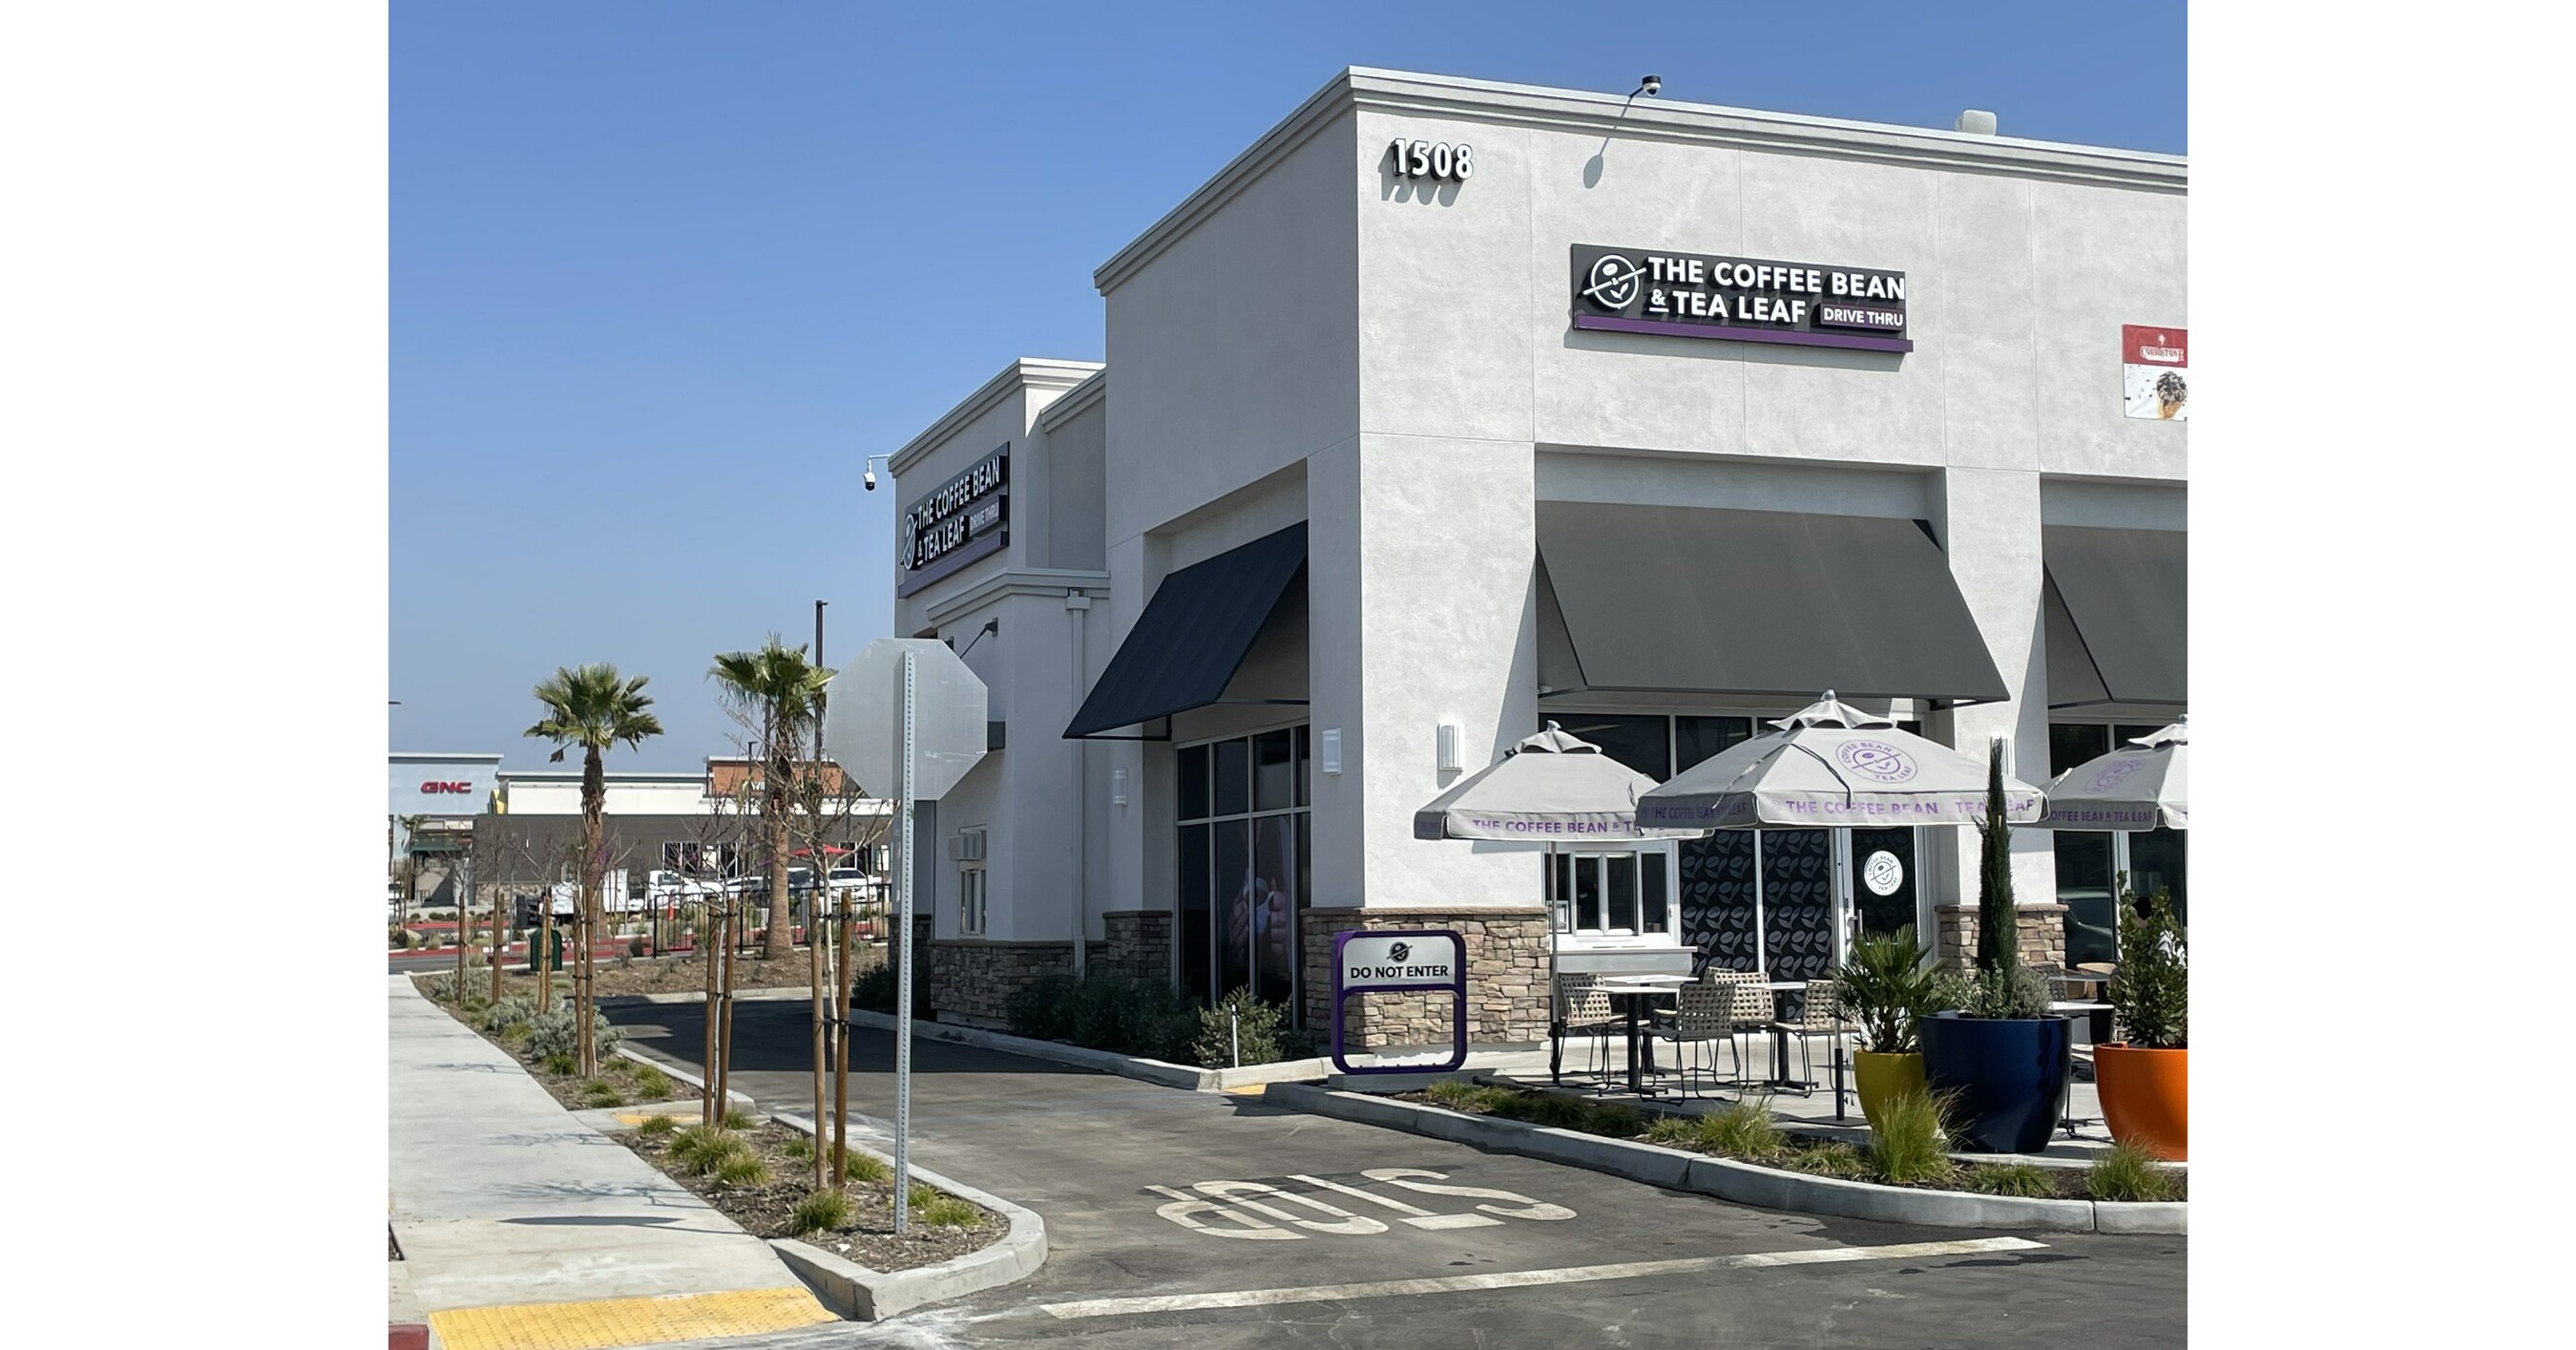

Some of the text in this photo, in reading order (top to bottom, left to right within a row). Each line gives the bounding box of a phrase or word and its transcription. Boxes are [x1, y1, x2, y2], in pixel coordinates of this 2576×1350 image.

[1393, 137, 1474, 180] 1508
[1647, 256, 1905, 300] THE COFFEE BEAN
[1649, 288, 1807, 324] & TEA LEAF
[1824, 306, 1904, 327] DRIVE THRU
[917, 455, 999, 530] THE COFFEE BEAN
[924, 531, 941, 561] TEA
[942, 516, 964, 552] LEAF
[1860, 742, 1892, 753] BEAN
[421, 780, 471, 794] GNC
[1787, 800, 1817, 813] THE
[2048, 811, 2079, 821] OFFEE
[2081, 812, 2105, 821] BEAN
[2114, 812, 2128, 821] TEA
[2132, 811, 2153, 821] LEAF
[1473, 819, 1500, 830] THE
[1505, 820, 1561, 833] COFFEE
[1567, 821, 1607, 833] BEAN
[1351, 965, 1449, 979] DO NOT ENTER
[1142, 1167, 1579, 1241] STOP
